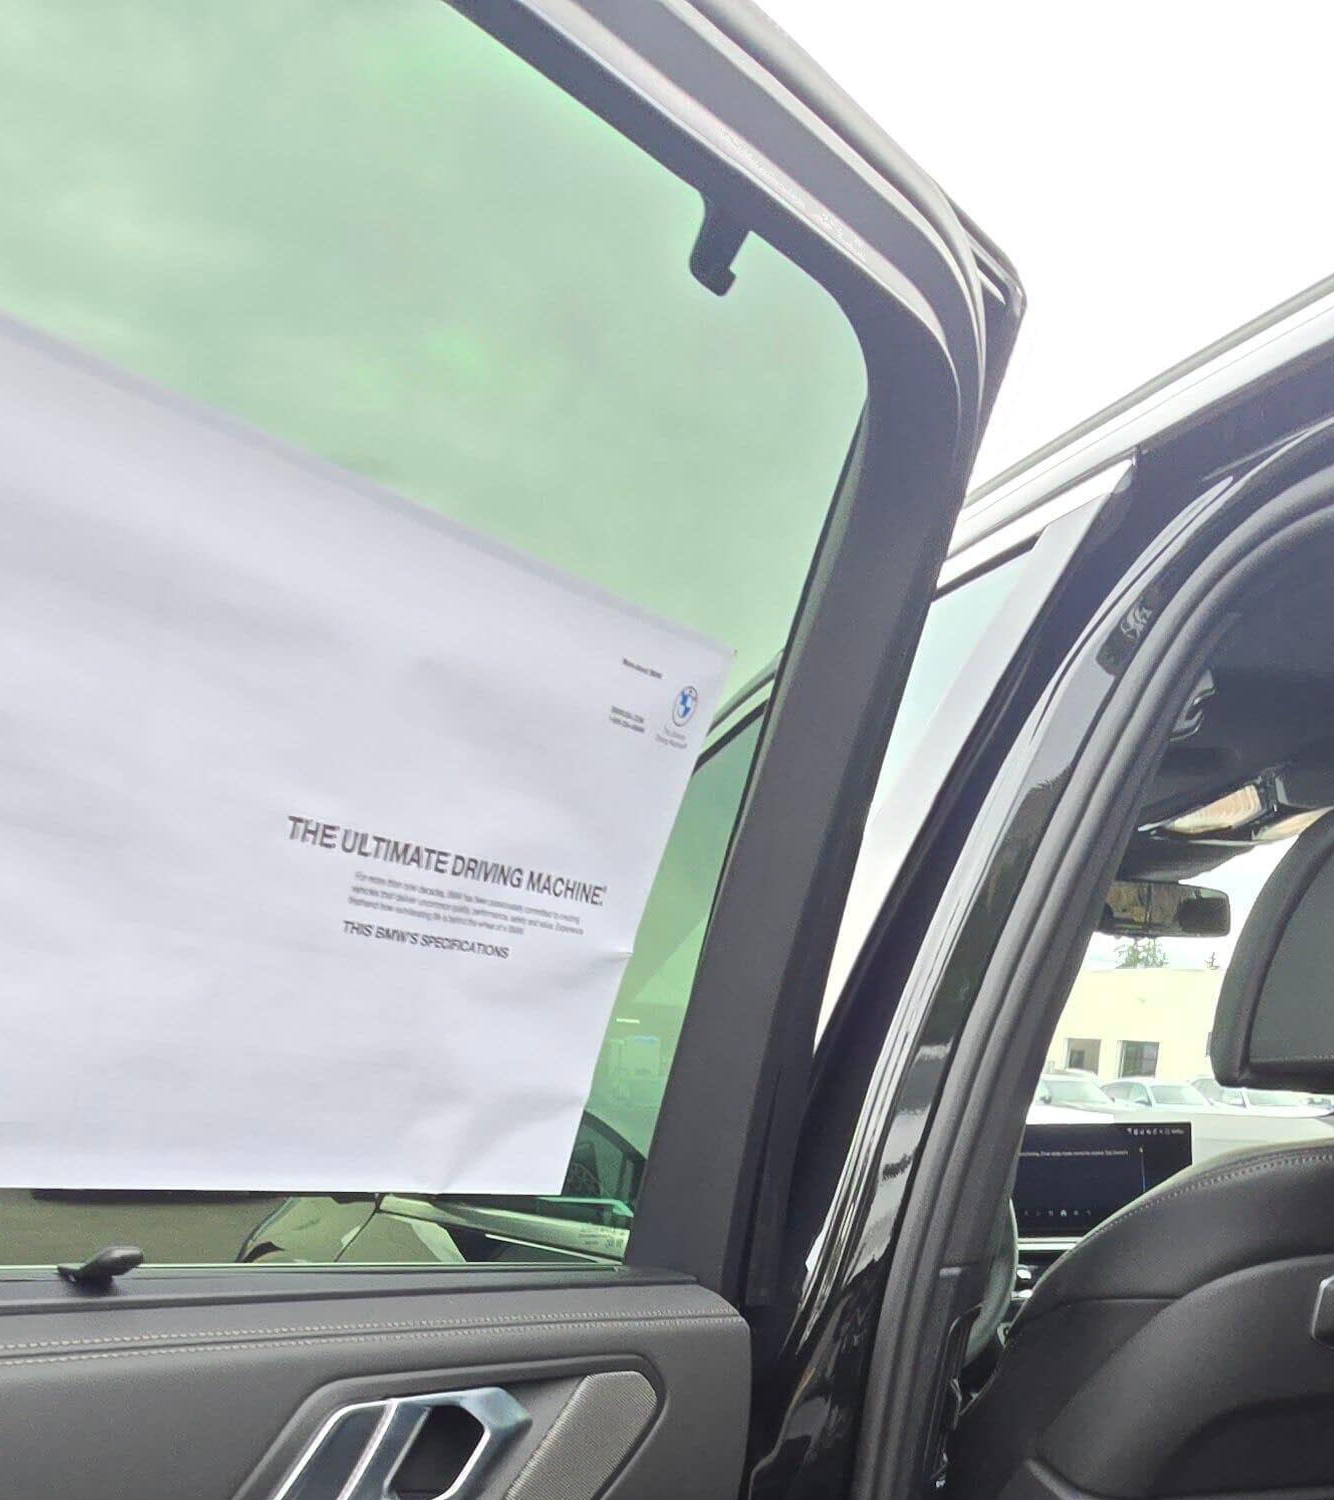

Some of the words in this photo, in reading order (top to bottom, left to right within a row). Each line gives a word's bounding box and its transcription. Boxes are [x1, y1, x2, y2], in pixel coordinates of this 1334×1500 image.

[288, 815, 340, 849] THE
[341, 829, 451, 874] ULTIMATE
[452, 854, 524, 888] DRIVING
[343, 920, 374, 937] THIS
[420, 934, 510, 959] SPECIFICATIONS
